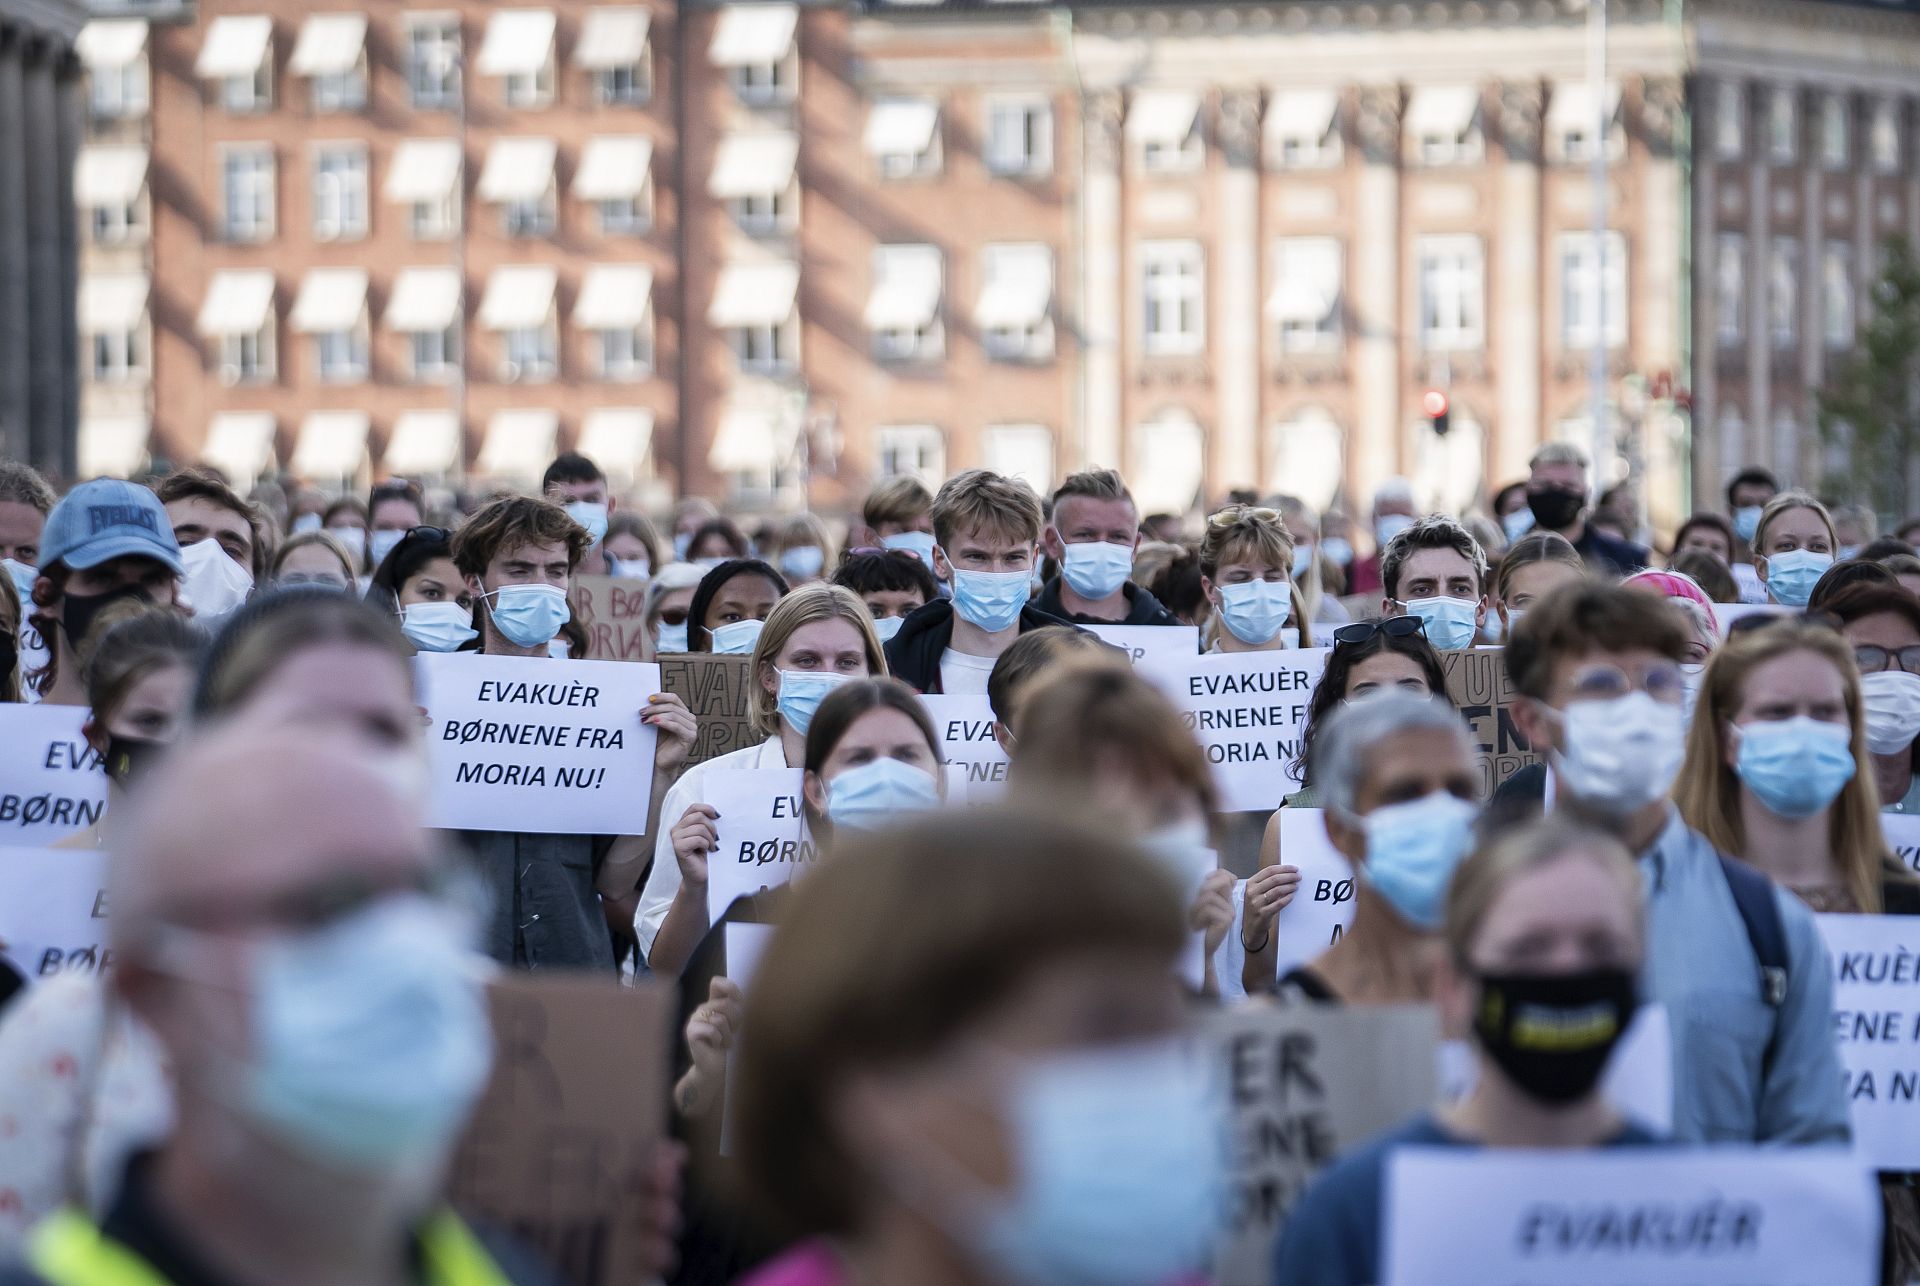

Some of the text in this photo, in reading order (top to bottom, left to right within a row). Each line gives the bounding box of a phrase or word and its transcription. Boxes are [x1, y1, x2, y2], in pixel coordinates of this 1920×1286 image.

[477, 680, 600, 708] EVAKUÈR
[1189, 666, 1310, 697] EVAKUÈR
[946, 720, 998, 742] EVA
[1180, 704, 1305, 730] ØRNENE F
[442, 719, 624, 750] BØRNENE FRA
[45, 741, 107, 771] EVA
[1200, 741, 1270, 764] ORIA
[455, 762, 606, 789] MORIA NU!
[0, 793, 104, 827] BØRN
[771, 796, 804, 819] EV
[738, 837, 817, 867] BØRN
[1313, 876, 1358, 906] BØ
[1839, 943, 1920, 984] KUÈ
[1834, 1010, 1903, 1042] ENE
[1231, 1029, 1325, 1106] ER
